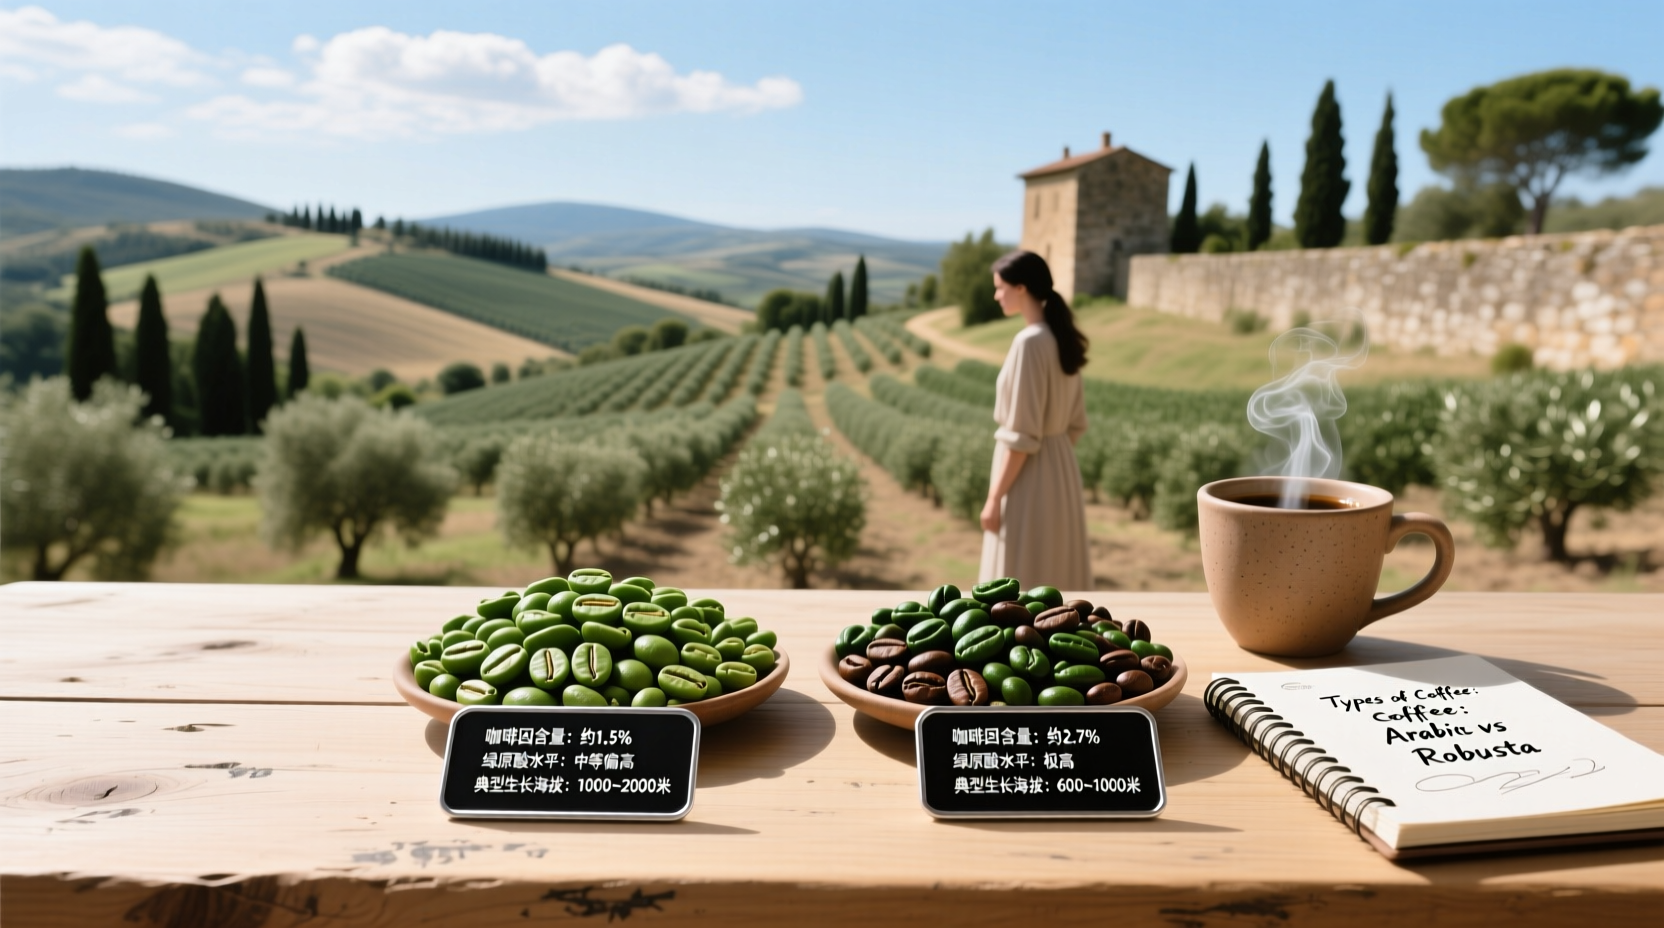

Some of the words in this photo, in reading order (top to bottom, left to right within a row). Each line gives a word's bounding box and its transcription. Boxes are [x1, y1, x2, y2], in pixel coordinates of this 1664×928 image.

[1319, 695, 1384, 712] Types
[1390, 690, 1408, 703] of
[1477, 721, 1507, 734] vs
[1411, 740, 1542, 766] Robusta
